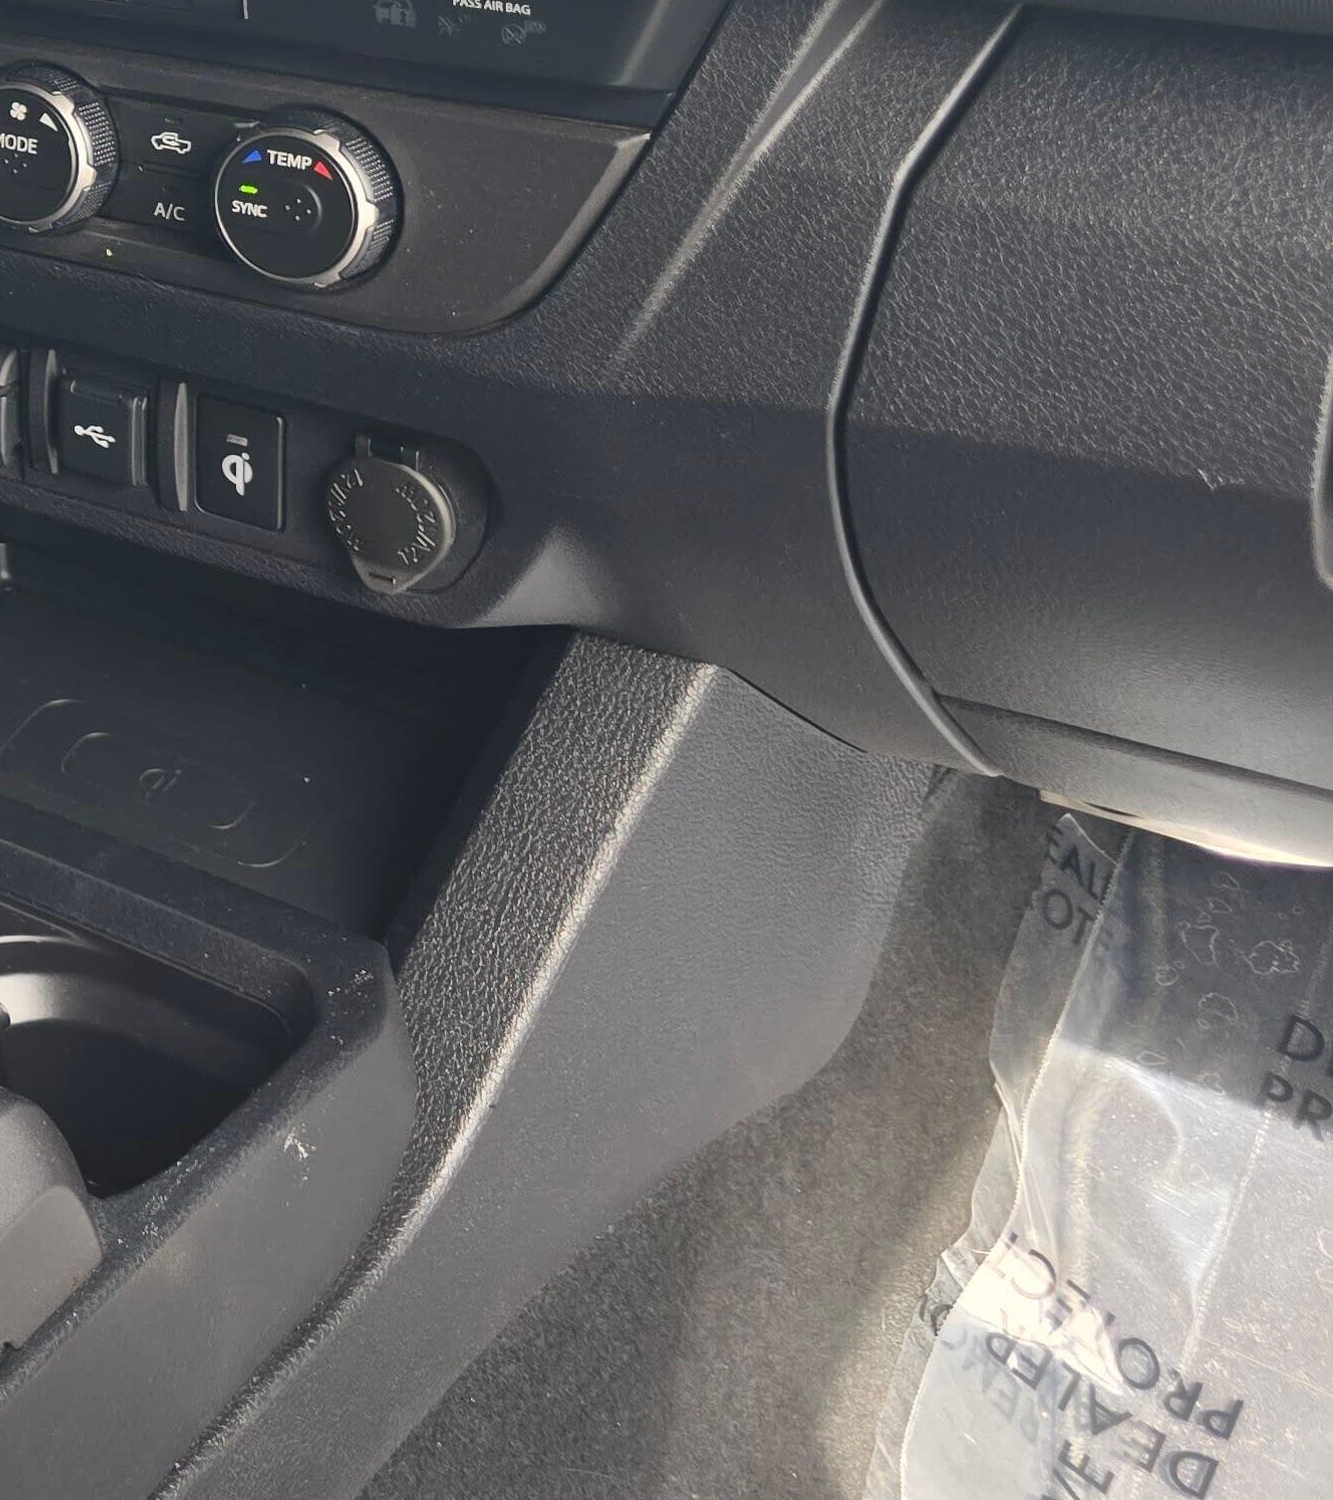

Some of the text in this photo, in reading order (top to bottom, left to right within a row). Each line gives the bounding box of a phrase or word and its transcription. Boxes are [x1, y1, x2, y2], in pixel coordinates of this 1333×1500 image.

[483, 0, 504, 13] AIR
[505, 2, 531, 16] BAG
[266, 148, 313, 171] TEMP
[153, 201, 186, 223] A/C
[231, 199, 268, 219] SYNC
